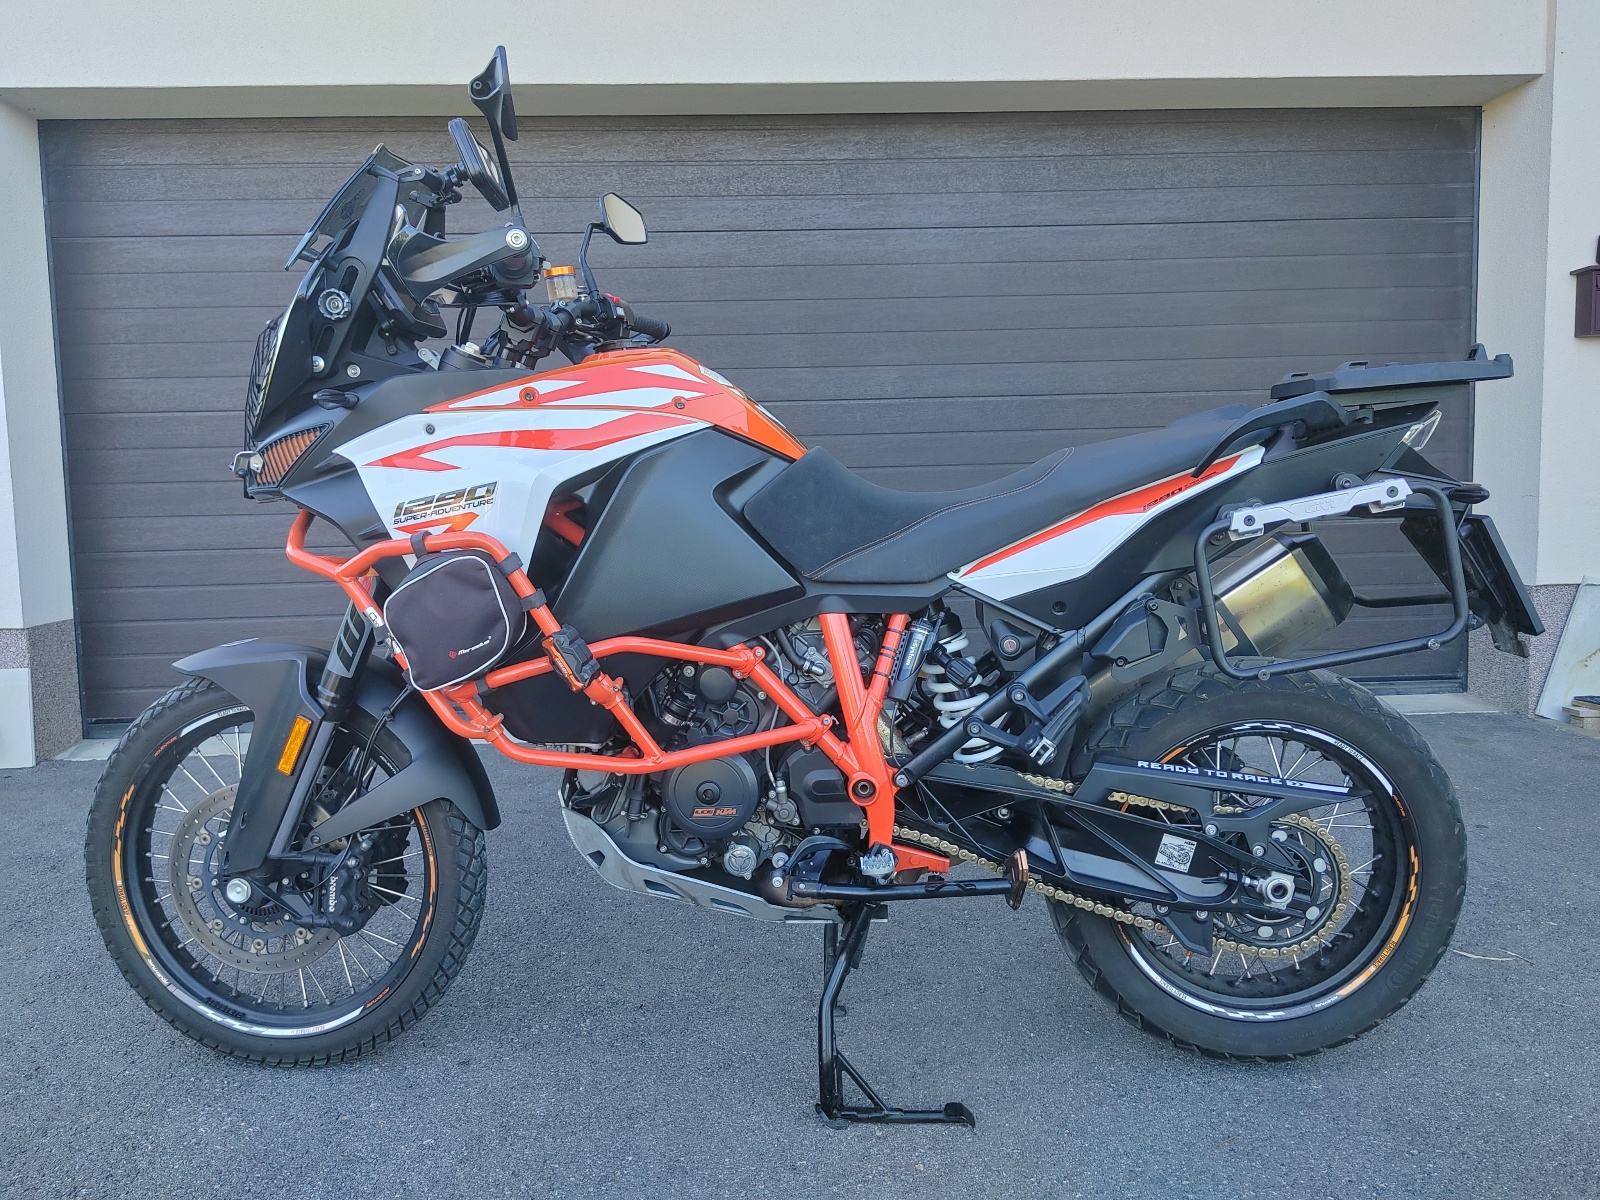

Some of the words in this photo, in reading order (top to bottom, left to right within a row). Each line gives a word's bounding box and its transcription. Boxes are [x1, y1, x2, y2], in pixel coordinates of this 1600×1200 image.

[394, 481, 497, 518] 1290
[1137, 760, 1199, 775] READY
[1203, 769, 1228, 778] TO
[1231, 772, 1283, 785] RACE
[329, 876, 339, 913] brembo
